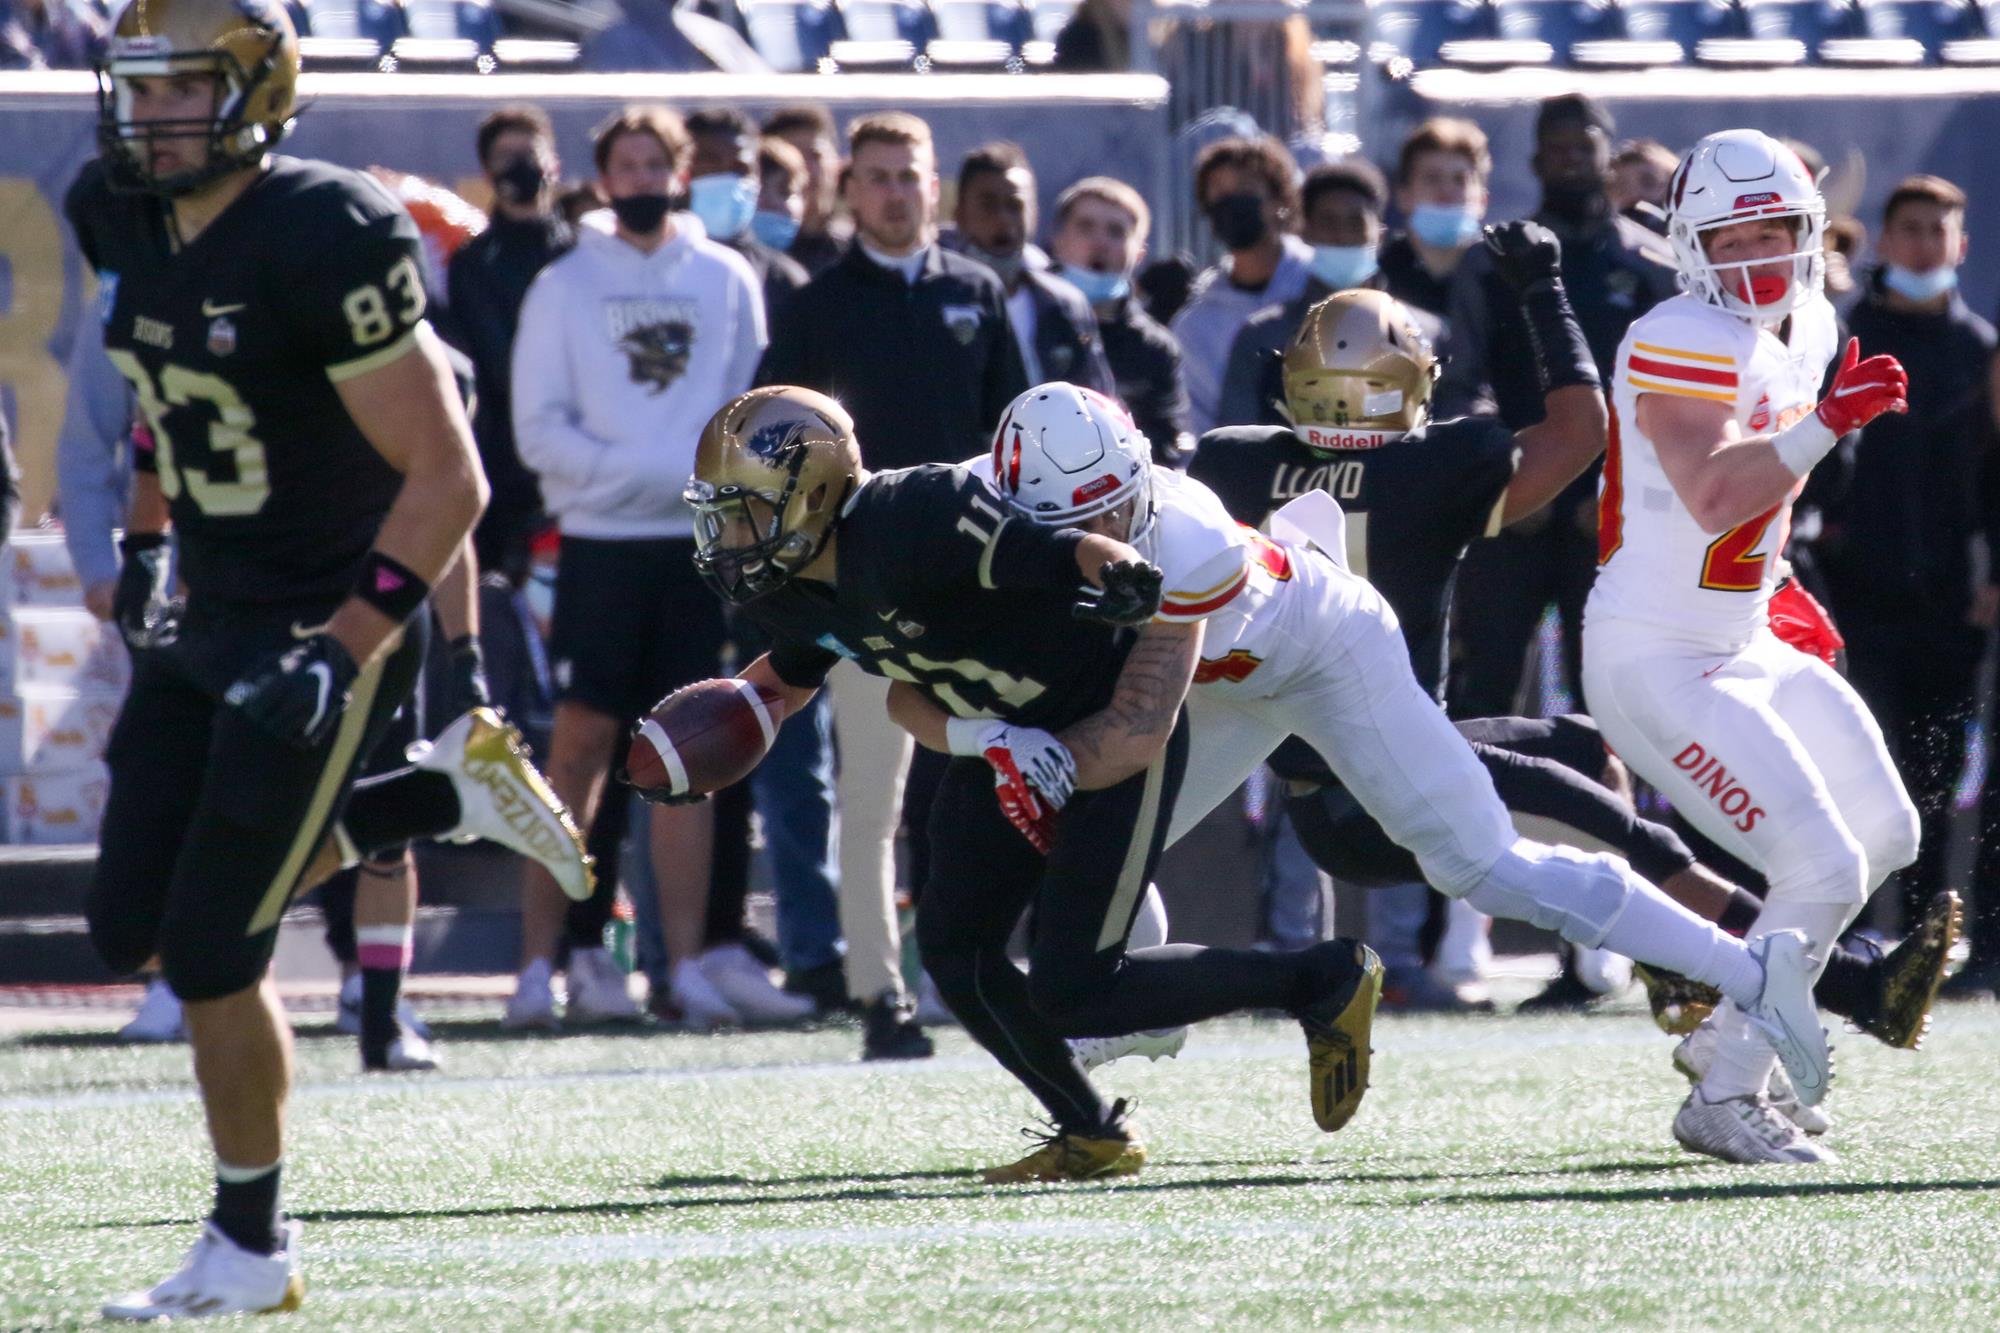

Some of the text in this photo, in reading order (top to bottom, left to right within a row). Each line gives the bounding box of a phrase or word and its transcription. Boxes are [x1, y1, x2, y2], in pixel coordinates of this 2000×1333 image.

[1744, 194, 1771, 203] DINOS
[342, 255, 427, 346] 83
[1308, 430, 1384, 448] Riddell
[1081, 479, 1108, 495] DINOS
[1270, 460, 1365, 499] LLOYD
[957, 494, 1004, 546] 11
[1671, 742, 1766, 833] DINOS
